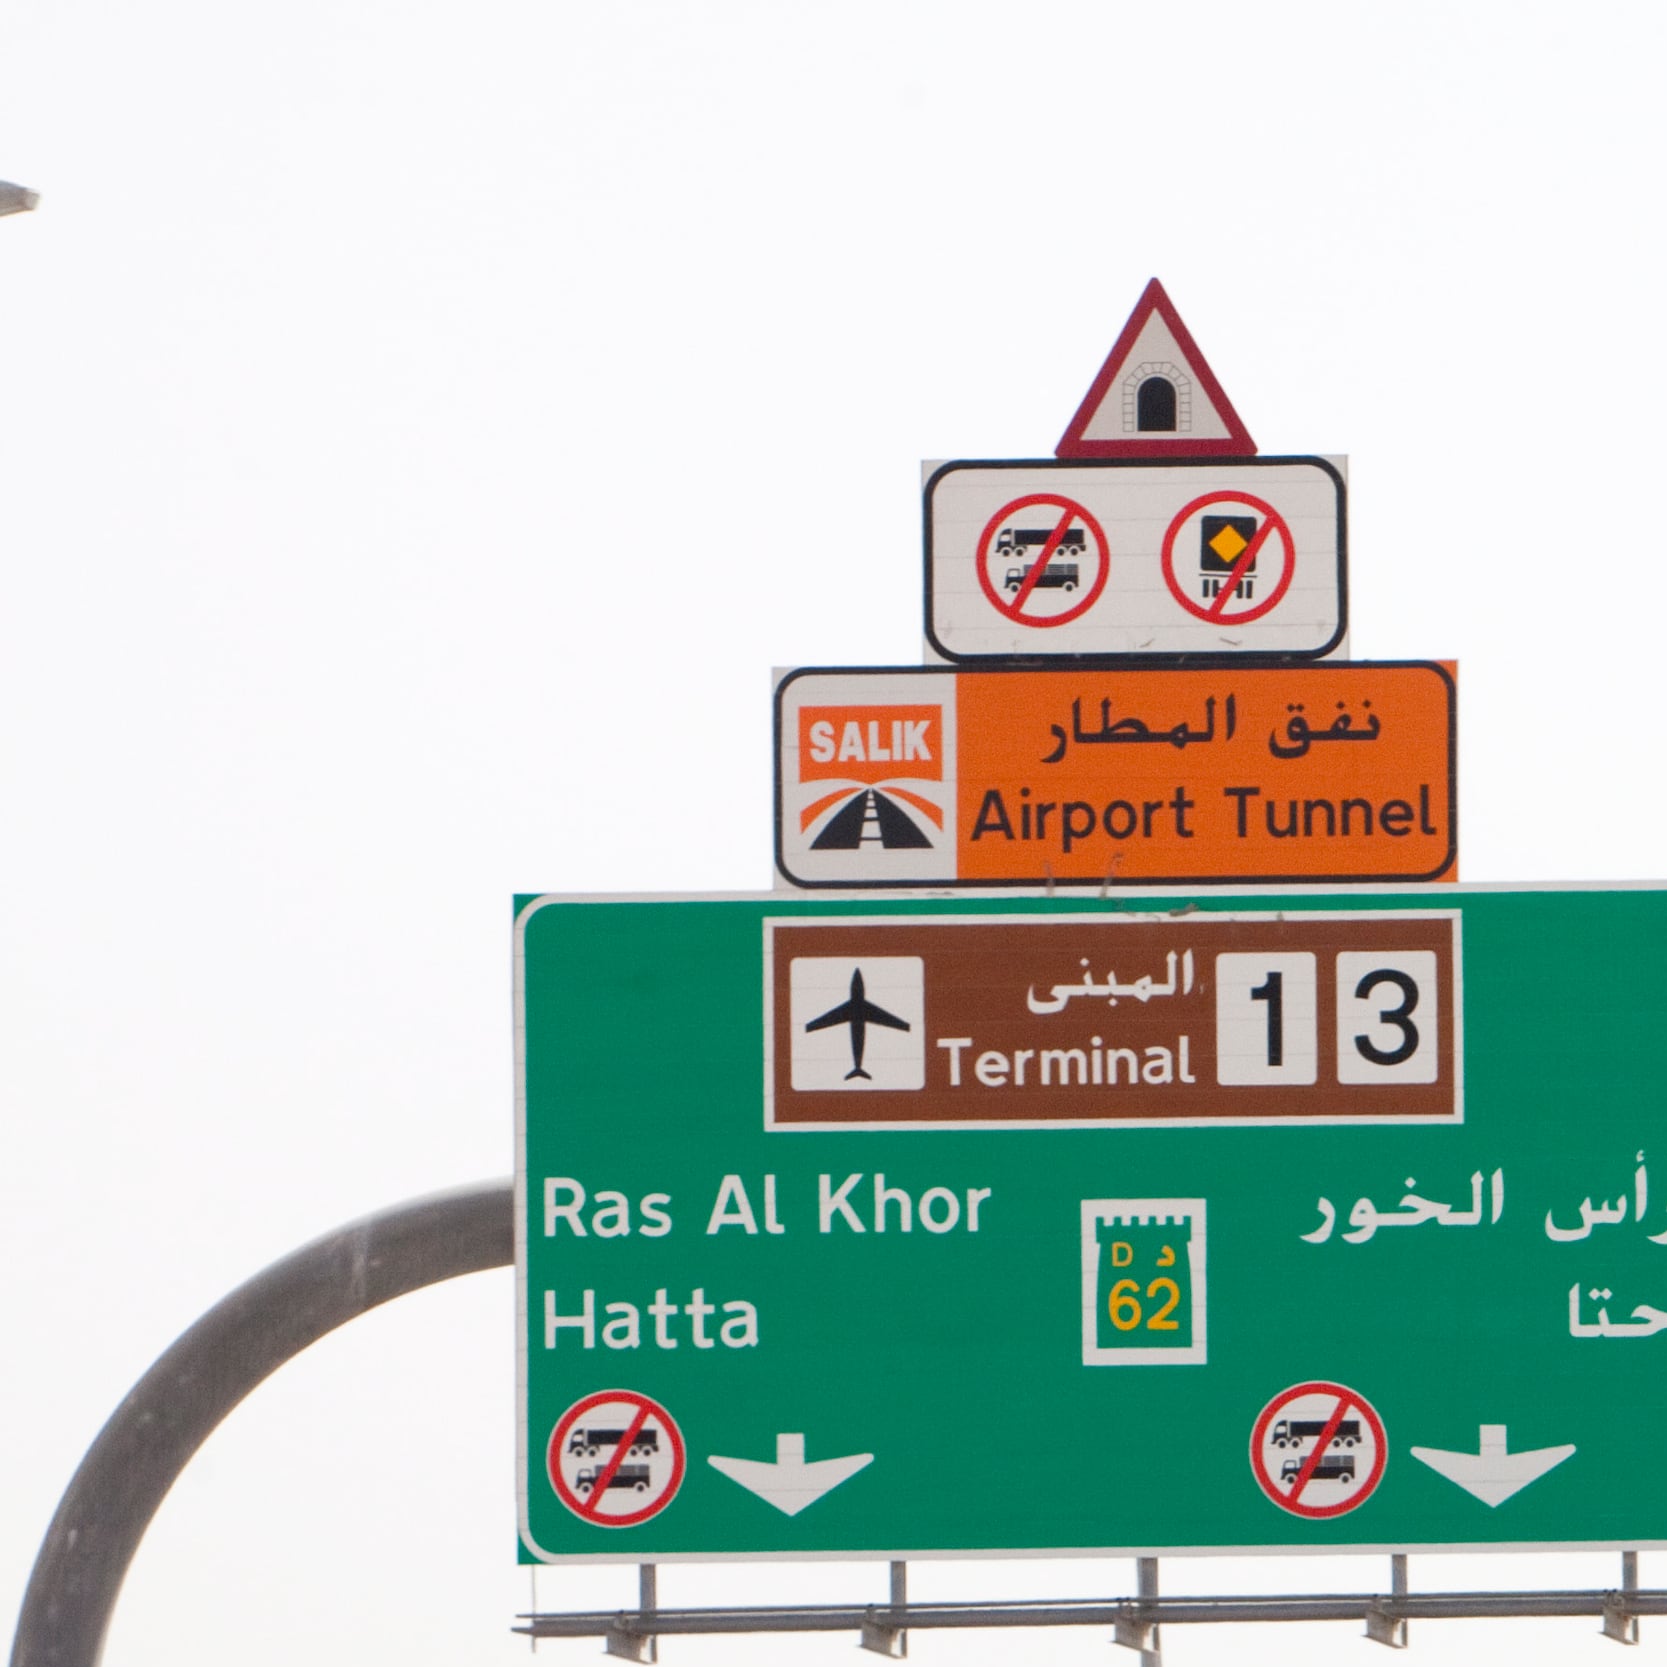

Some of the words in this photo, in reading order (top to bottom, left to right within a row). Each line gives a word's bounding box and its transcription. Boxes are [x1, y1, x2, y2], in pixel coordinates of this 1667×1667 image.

[809, 720, 932, 763] SALIK
[1041, 693, 1237, 764] المطار
[1268, 700, 1381, 760] نفق
[970, 786, 1195, 854] Airport
[1223, 783, 1437, 839] Tunnel
[1027, 948, 1195, 1015] المبنى
[1250, 971, 1283, 1067] 1
[1354, 968, 1420, 1066] 3
[936, 1035, 1196, 1087] Terminal
[543, 1176, 672, 1239] Ras
[706, 1173, 785, 1235] Al
[818, 1172, 992, 1234] Khor
[1300, 1167, 1505, 1244] الخور
[1111, 1241, 1134, 1268] D
[544, 1287, 759, 1350] Hatta
[1108, 1277, 1181, 1331] 62
